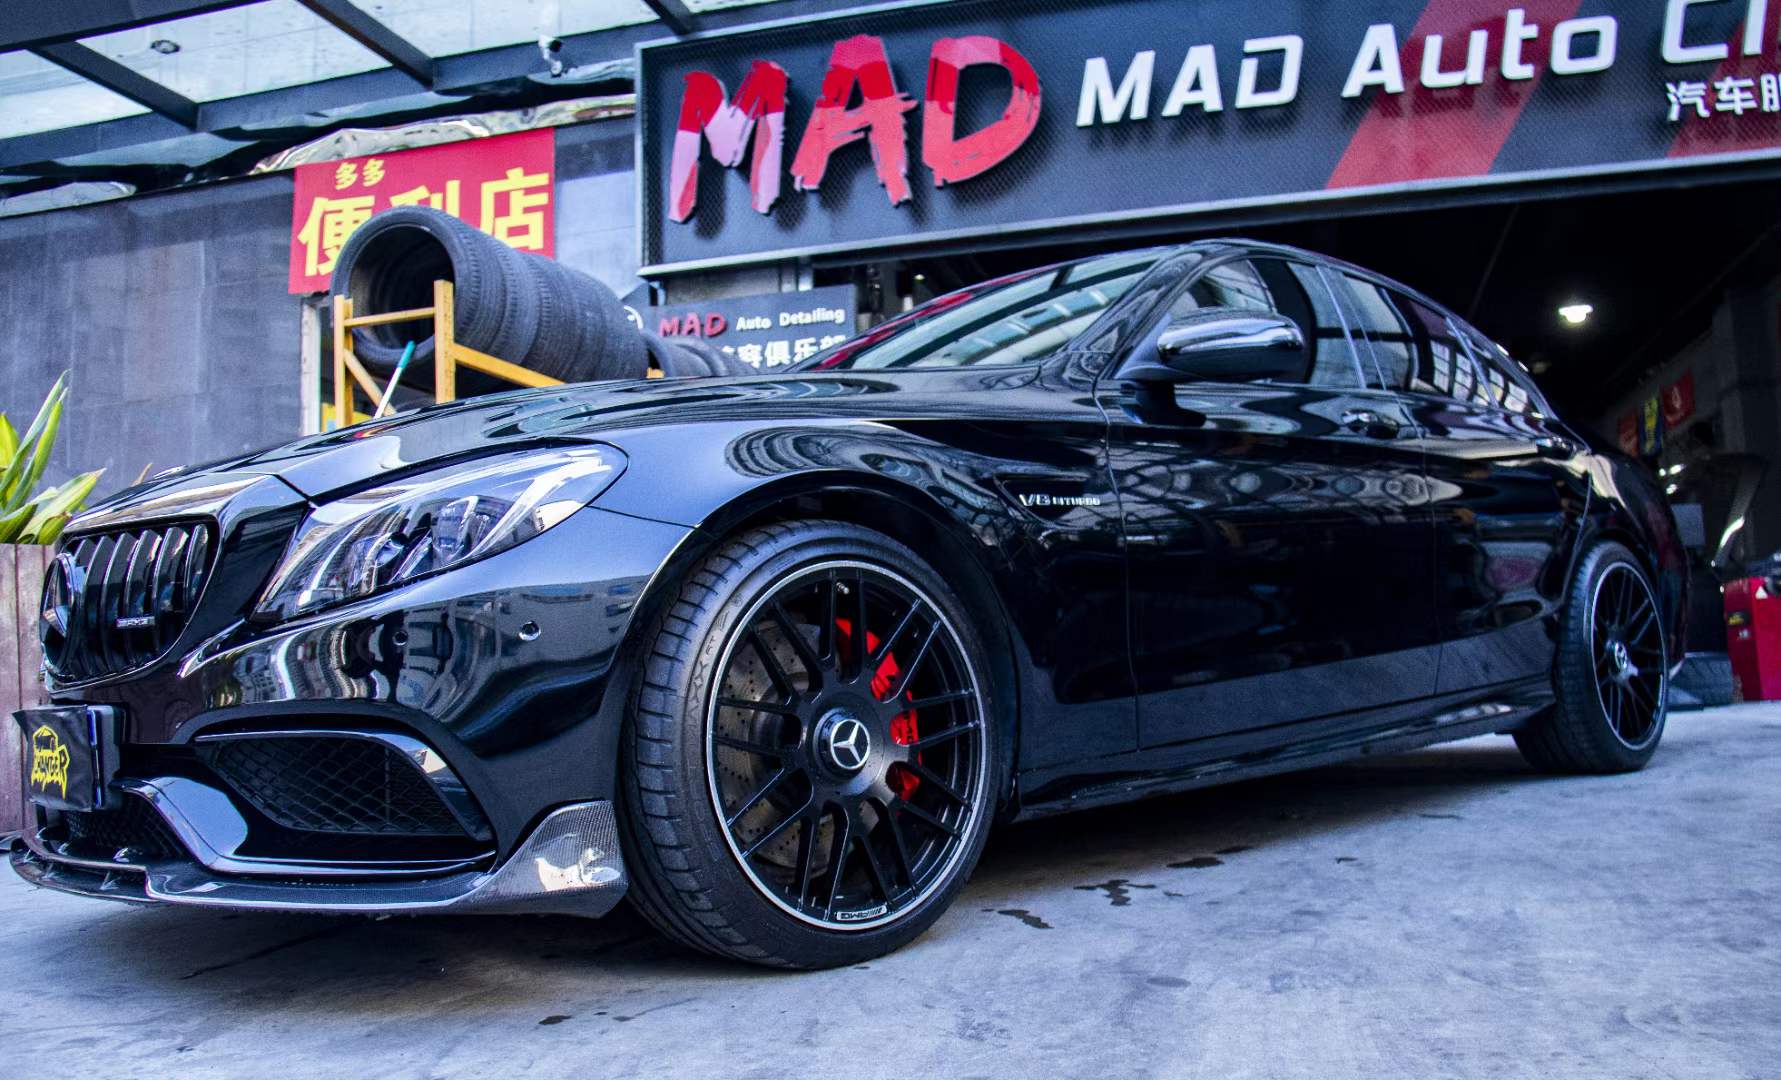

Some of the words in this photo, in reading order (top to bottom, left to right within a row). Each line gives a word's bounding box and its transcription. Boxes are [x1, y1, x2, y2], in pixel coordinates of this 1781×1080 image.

[1075, 34, 1304, 127] MAD
[1341, 8, 1618, 98] Auto
[1661, 0, 1781, 63] Cl
[669, 34, 1042, 224] MAD
[335, 158, 386, 191] 多多
[658, 311, 728, 338] MAD
[736, 315, 772, 332] Auto
[779, 307, 846, 325] Detailing
